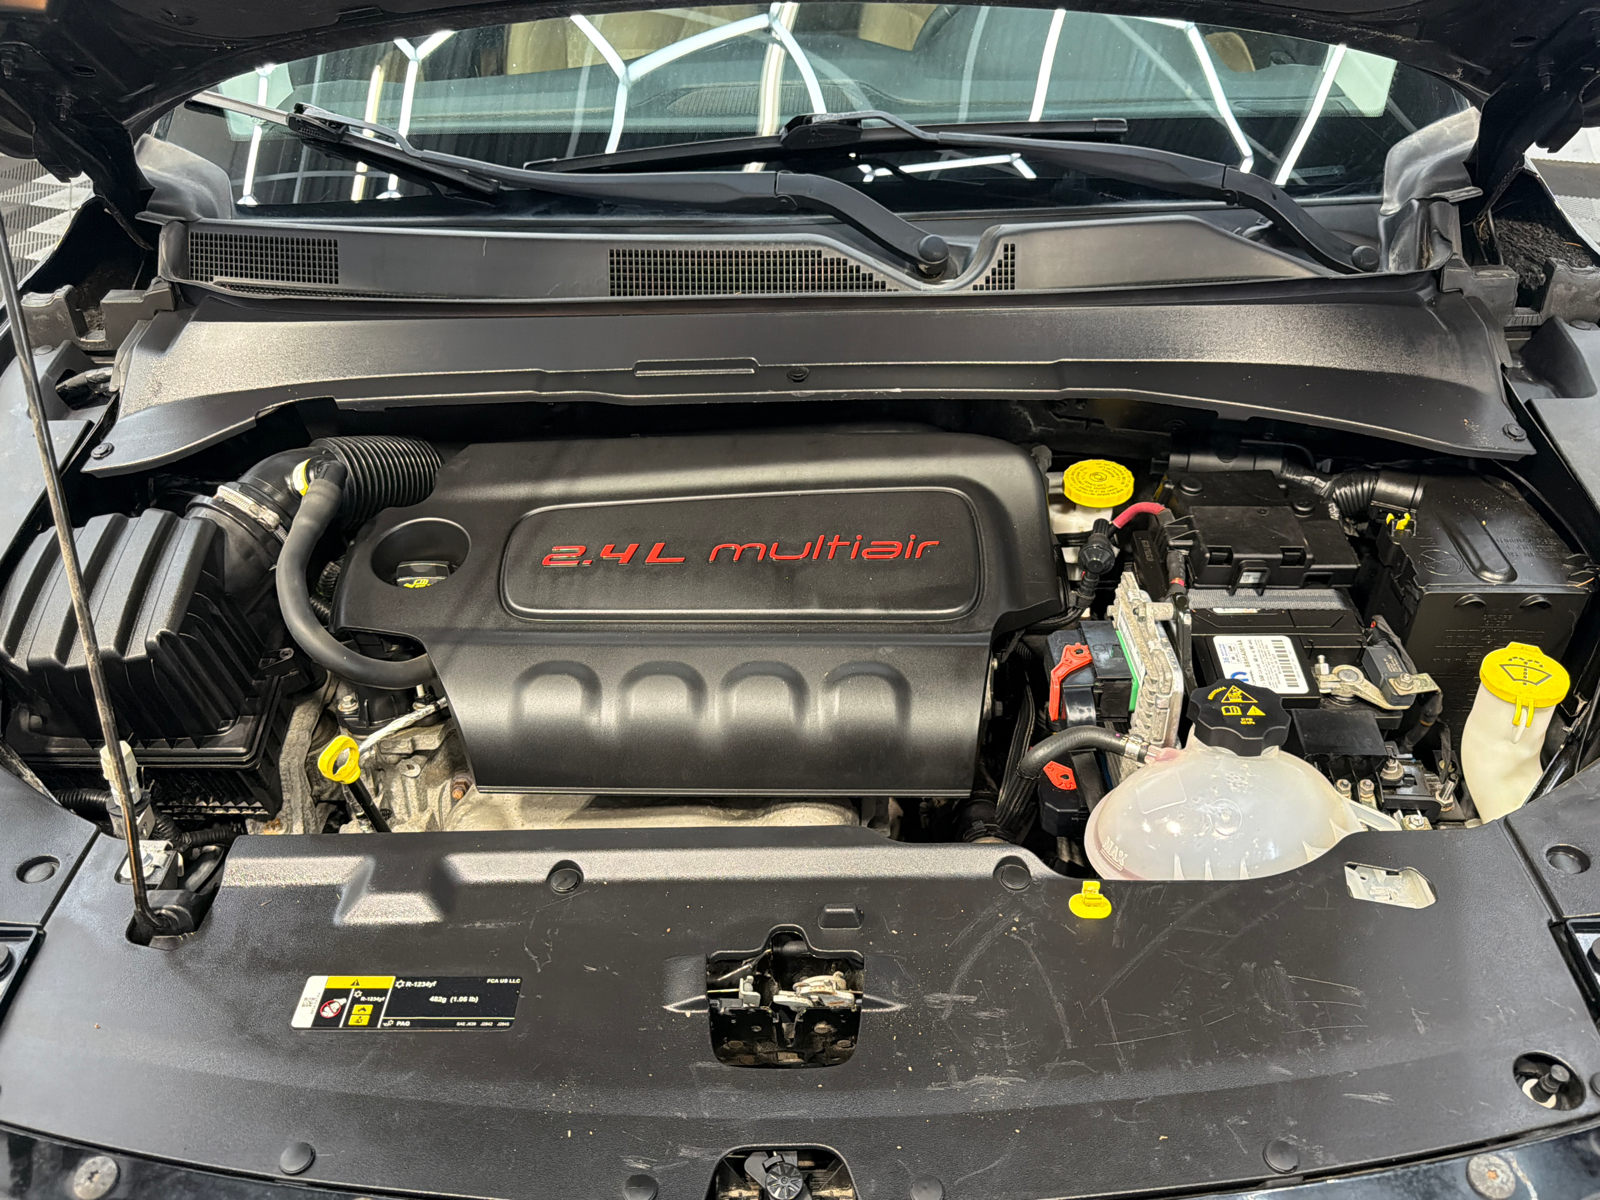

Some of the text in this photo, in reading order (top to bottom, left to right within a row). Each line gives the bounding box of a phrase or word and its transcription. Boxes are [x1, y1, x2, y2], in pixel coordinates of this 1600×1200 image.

[542, 534, 941, 567] 2.4L multiair
[1101, 836, 1129, 867] MAX
[405, 980, 437, 989] R-1234yf
[360, 995, 386, 1003] R-1234yf
